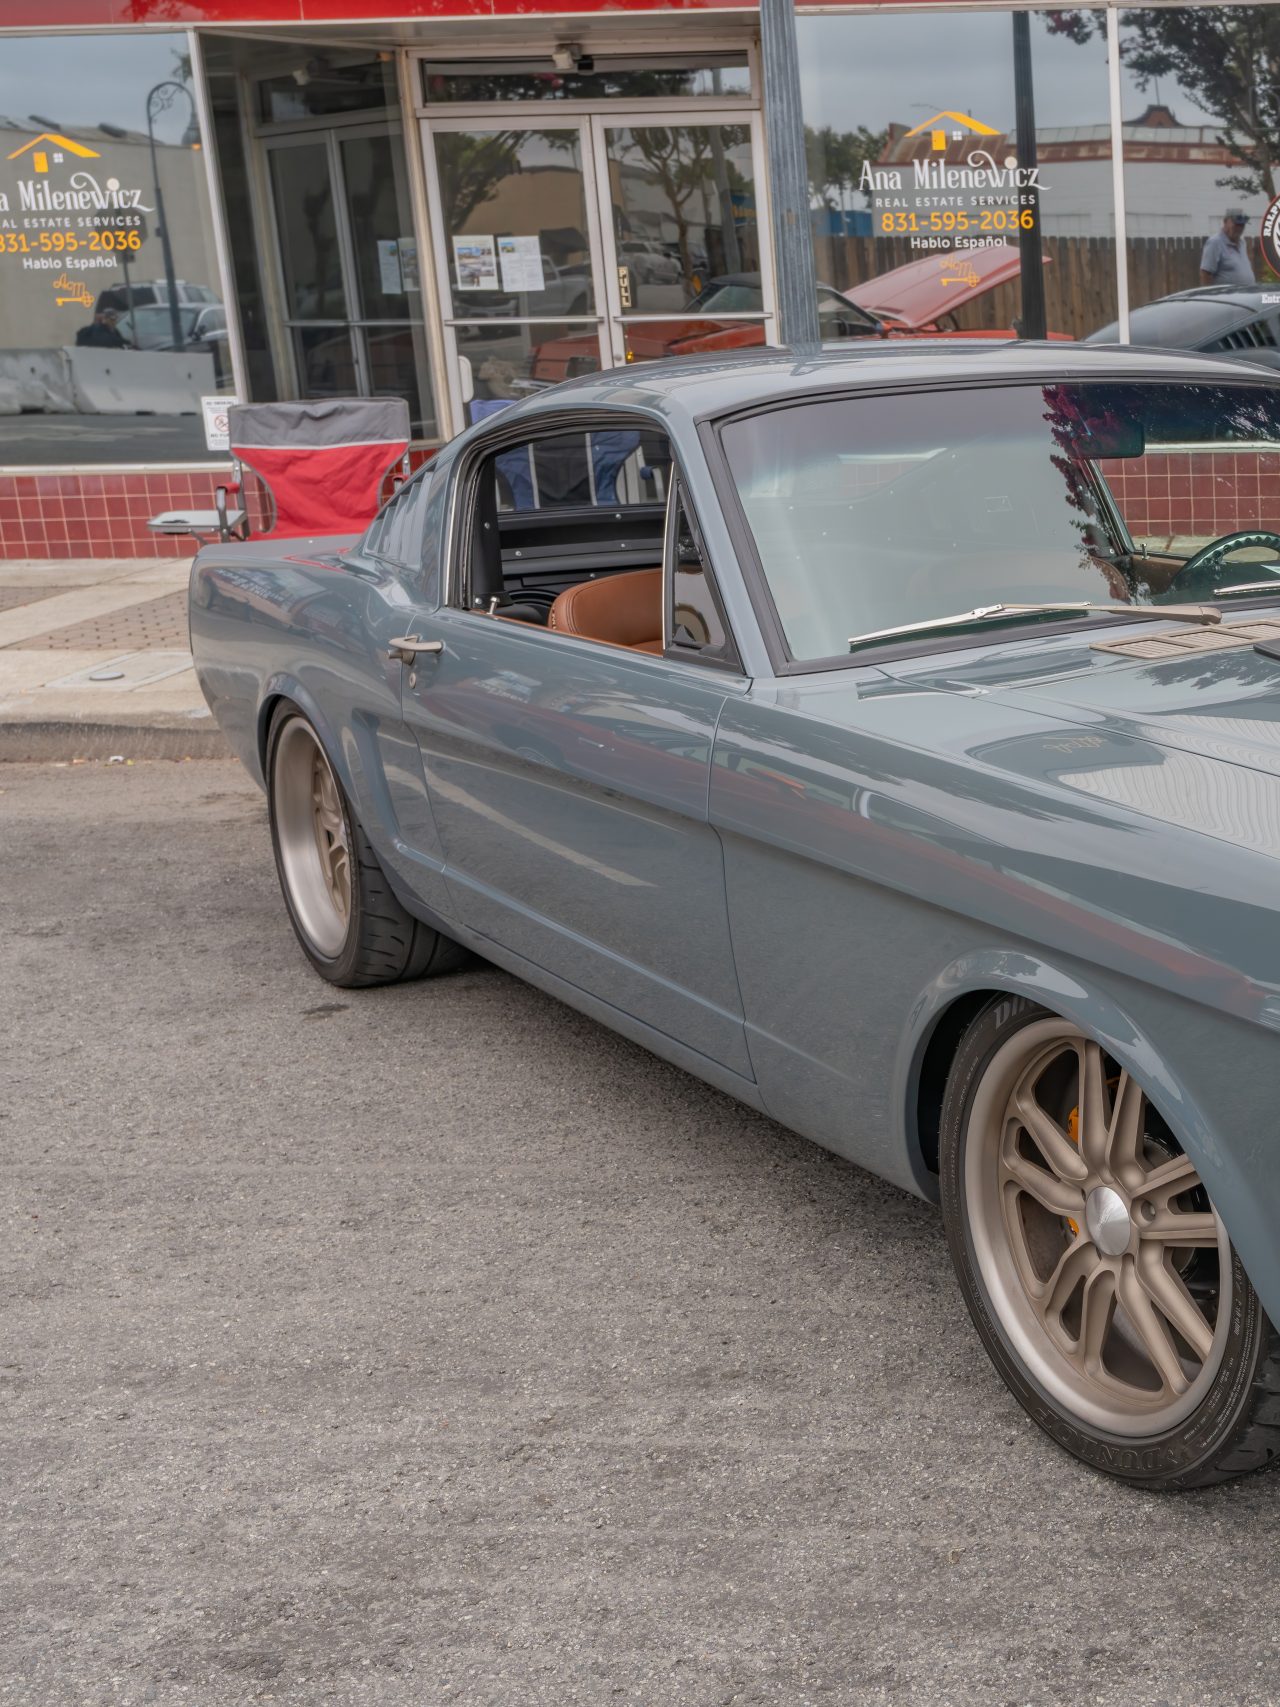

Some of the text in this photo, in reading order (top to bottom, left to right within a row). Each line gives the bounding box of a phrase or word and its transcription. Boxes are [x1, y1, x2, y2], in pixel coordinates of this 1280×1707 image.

[859, 150, 1053, 191] Ana Milenewicz
[17, 172, 155, 212] Milenewicz
[876, 194, 1036, 208] REAL ESTATE SERVICES
[0, 215, 141, 229] AL ESTATE SERVICES
[881, 209, 1034, 232] 831-595-2036
[911, 235, 1008, 250] Hablo Español
[23, 256, 118, 271] Hablo Español
[619, 266, 630, 307] PULL
